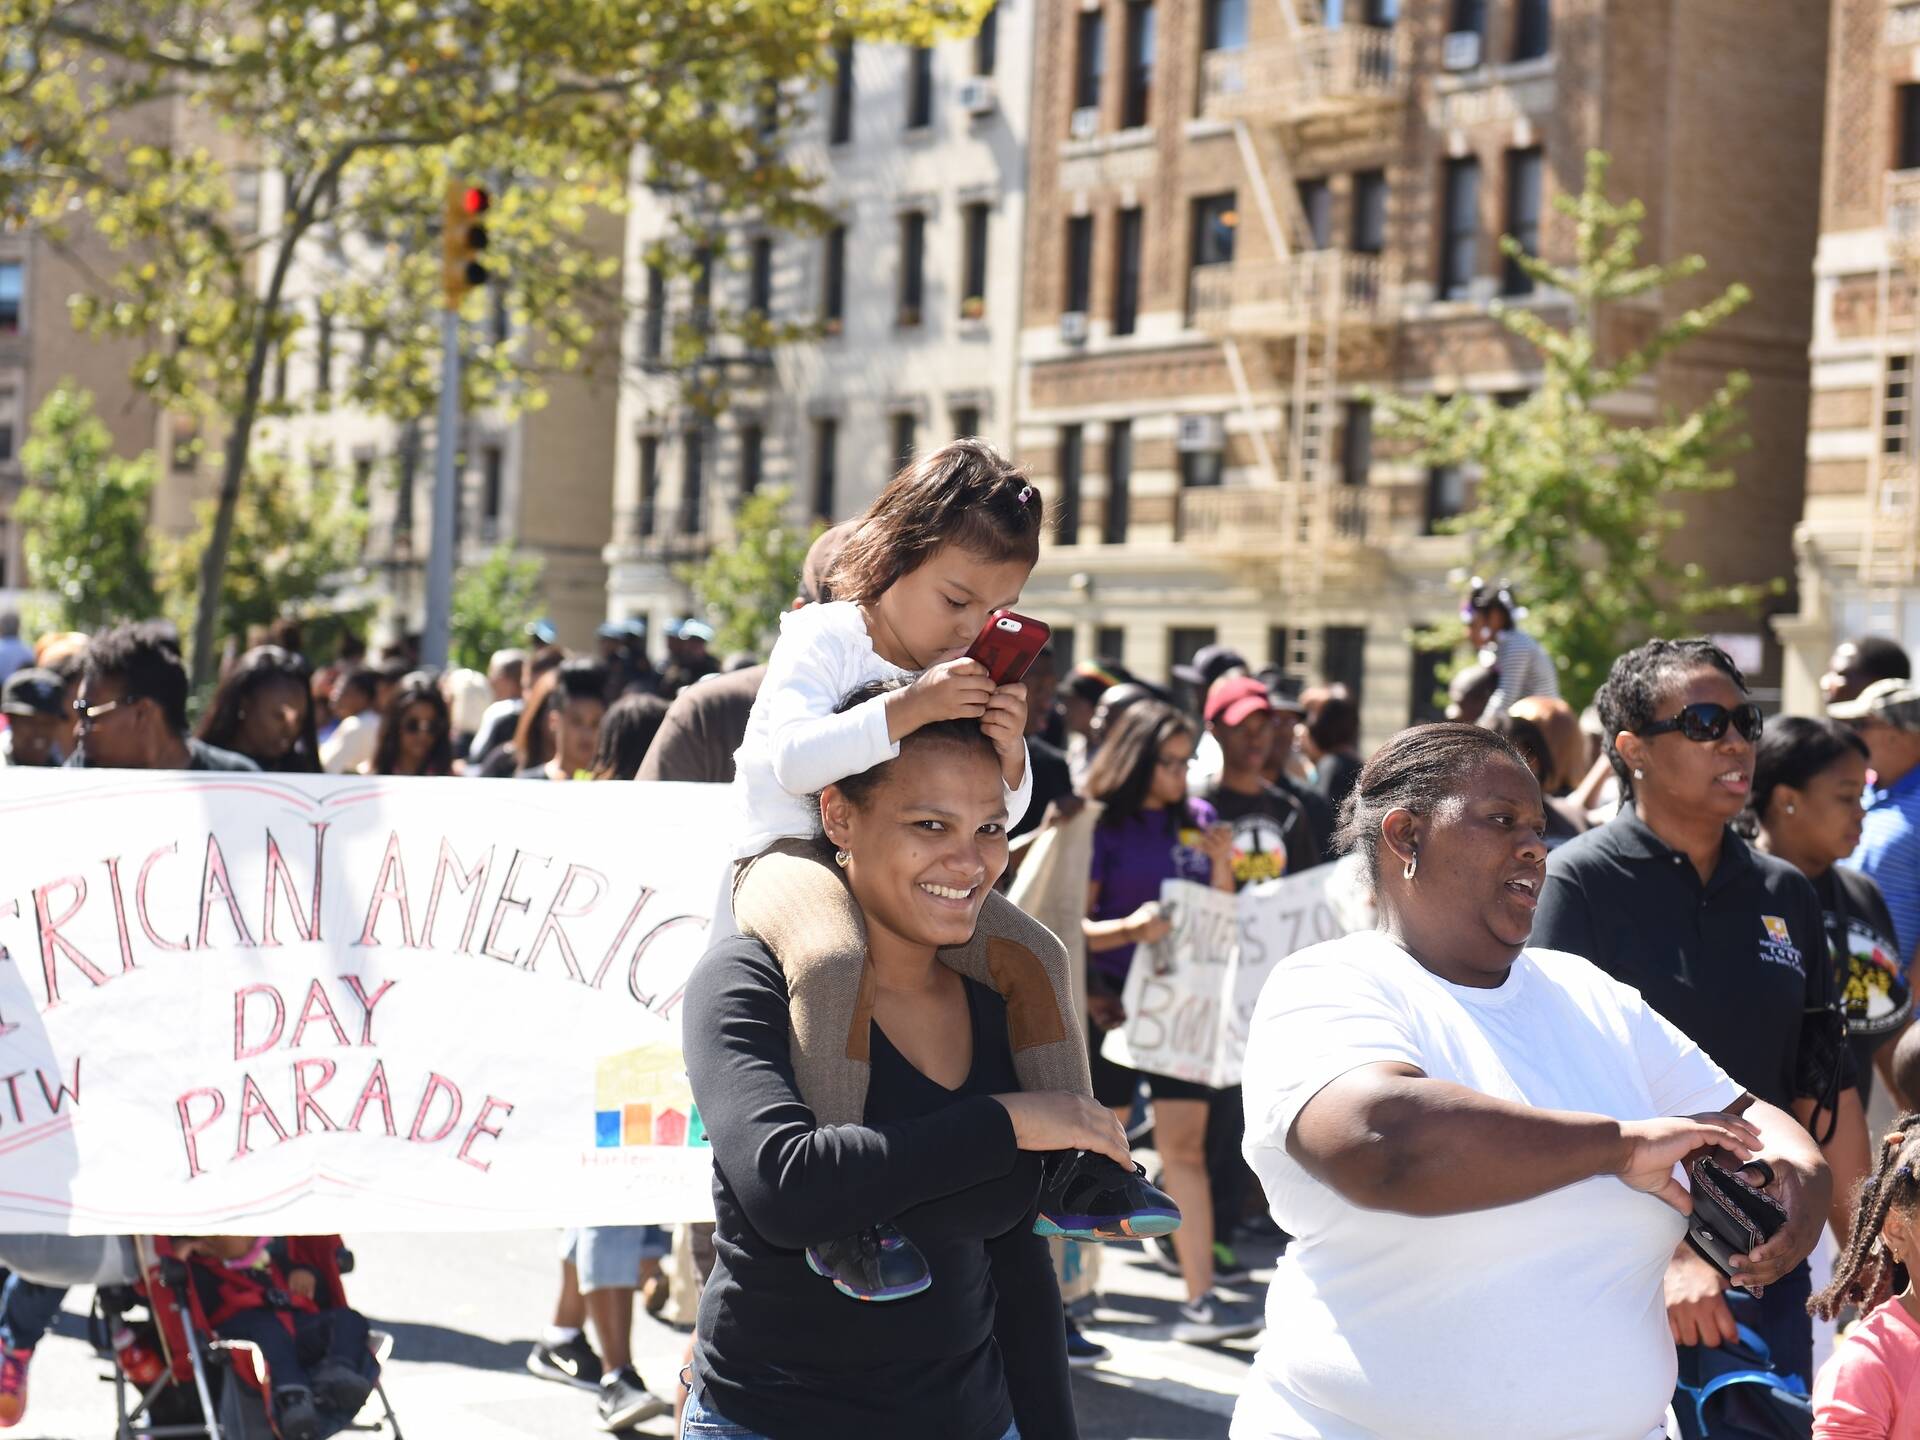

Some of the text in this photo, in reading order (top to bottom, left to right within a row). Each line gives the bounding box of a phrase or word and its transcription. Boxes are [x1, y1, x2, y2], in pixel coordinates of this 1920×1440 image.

[353, 829, 711, 1021] AMERIC
[233, 973, 399, 1061] DAY
[0, 1057, 82, 1131] TW
[175, 1057, 515, 1181] PARADE
